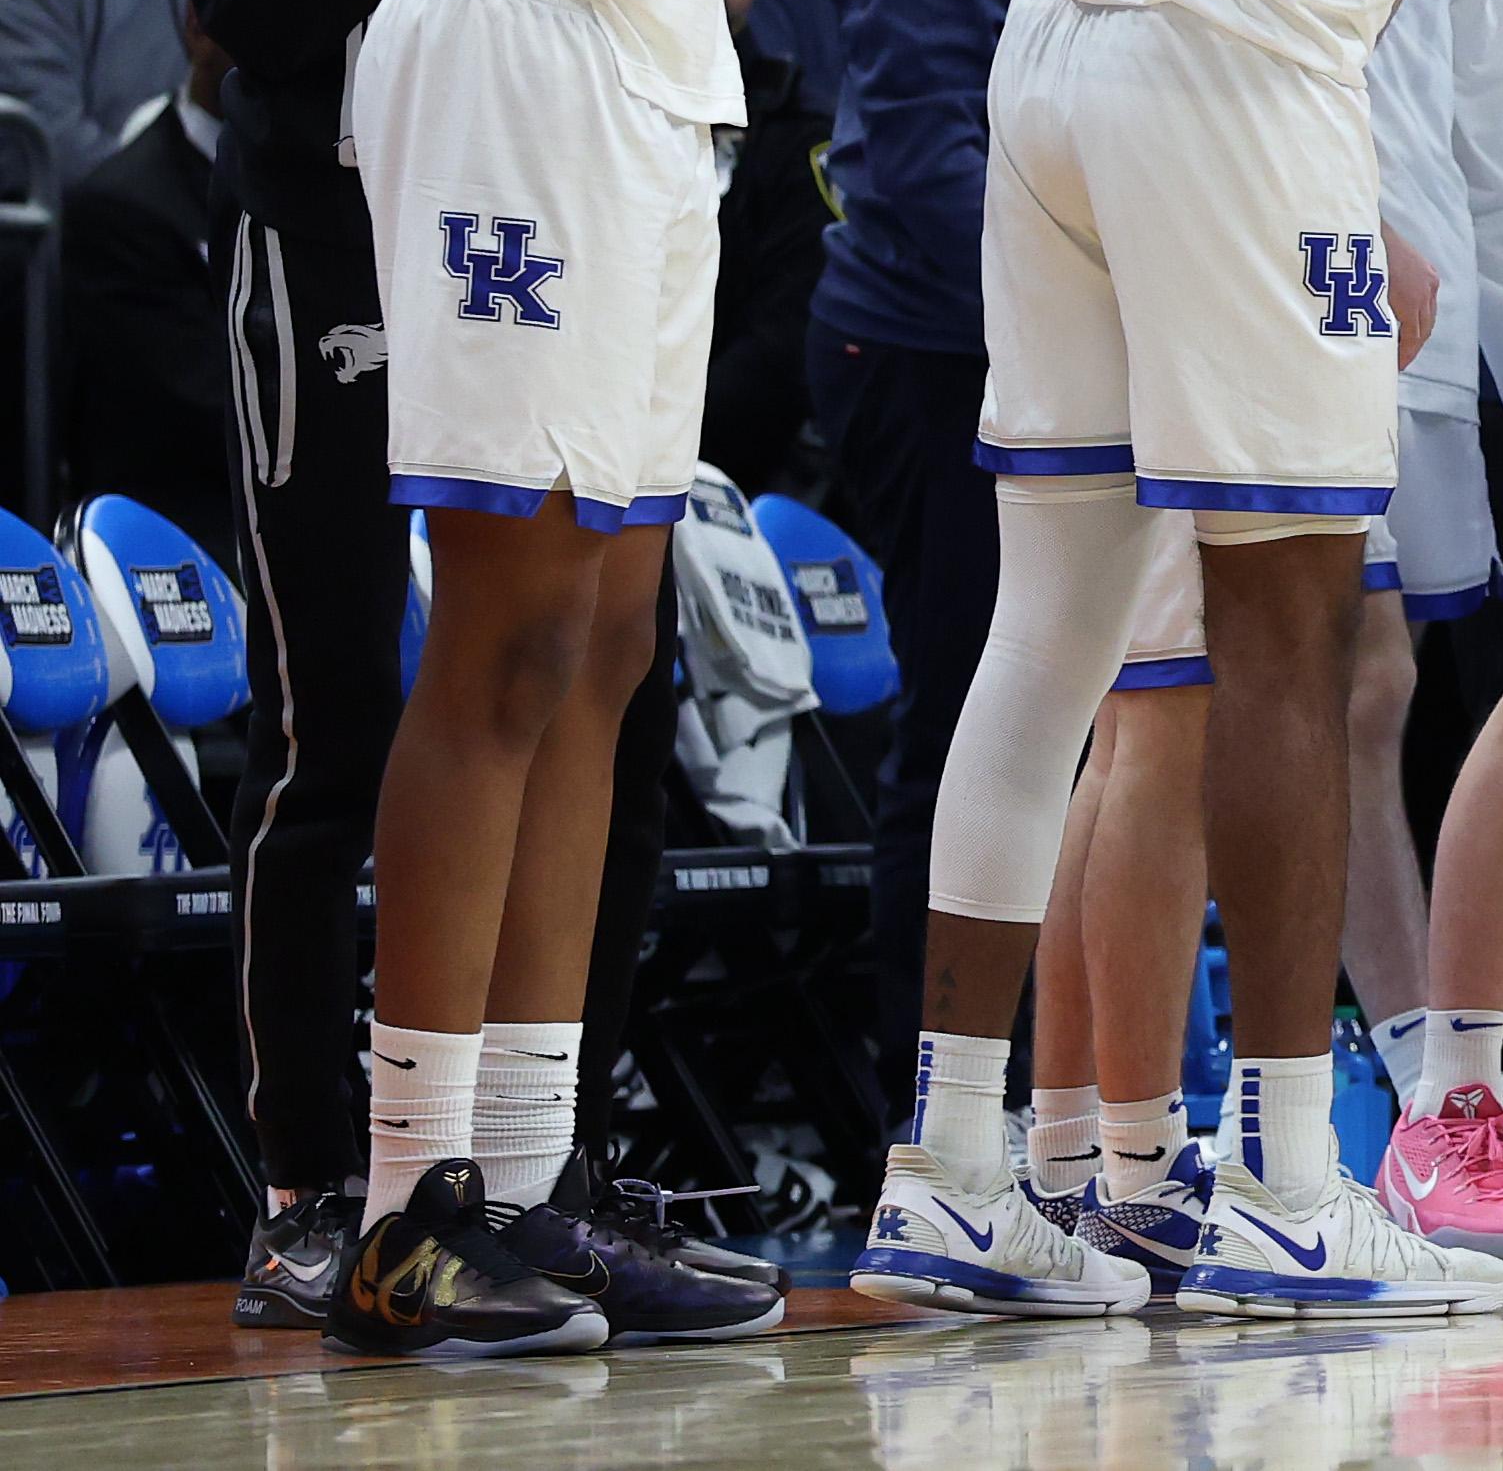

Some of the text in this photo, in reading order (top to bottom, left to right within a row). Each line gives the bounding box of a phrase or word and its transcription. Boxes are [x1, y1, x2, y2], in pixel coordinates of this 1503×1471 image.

[439, 210, 564, 330] UK
[1299, 231, 1393, 338] UK
[235, 1297, 264, 1315] FOAM
